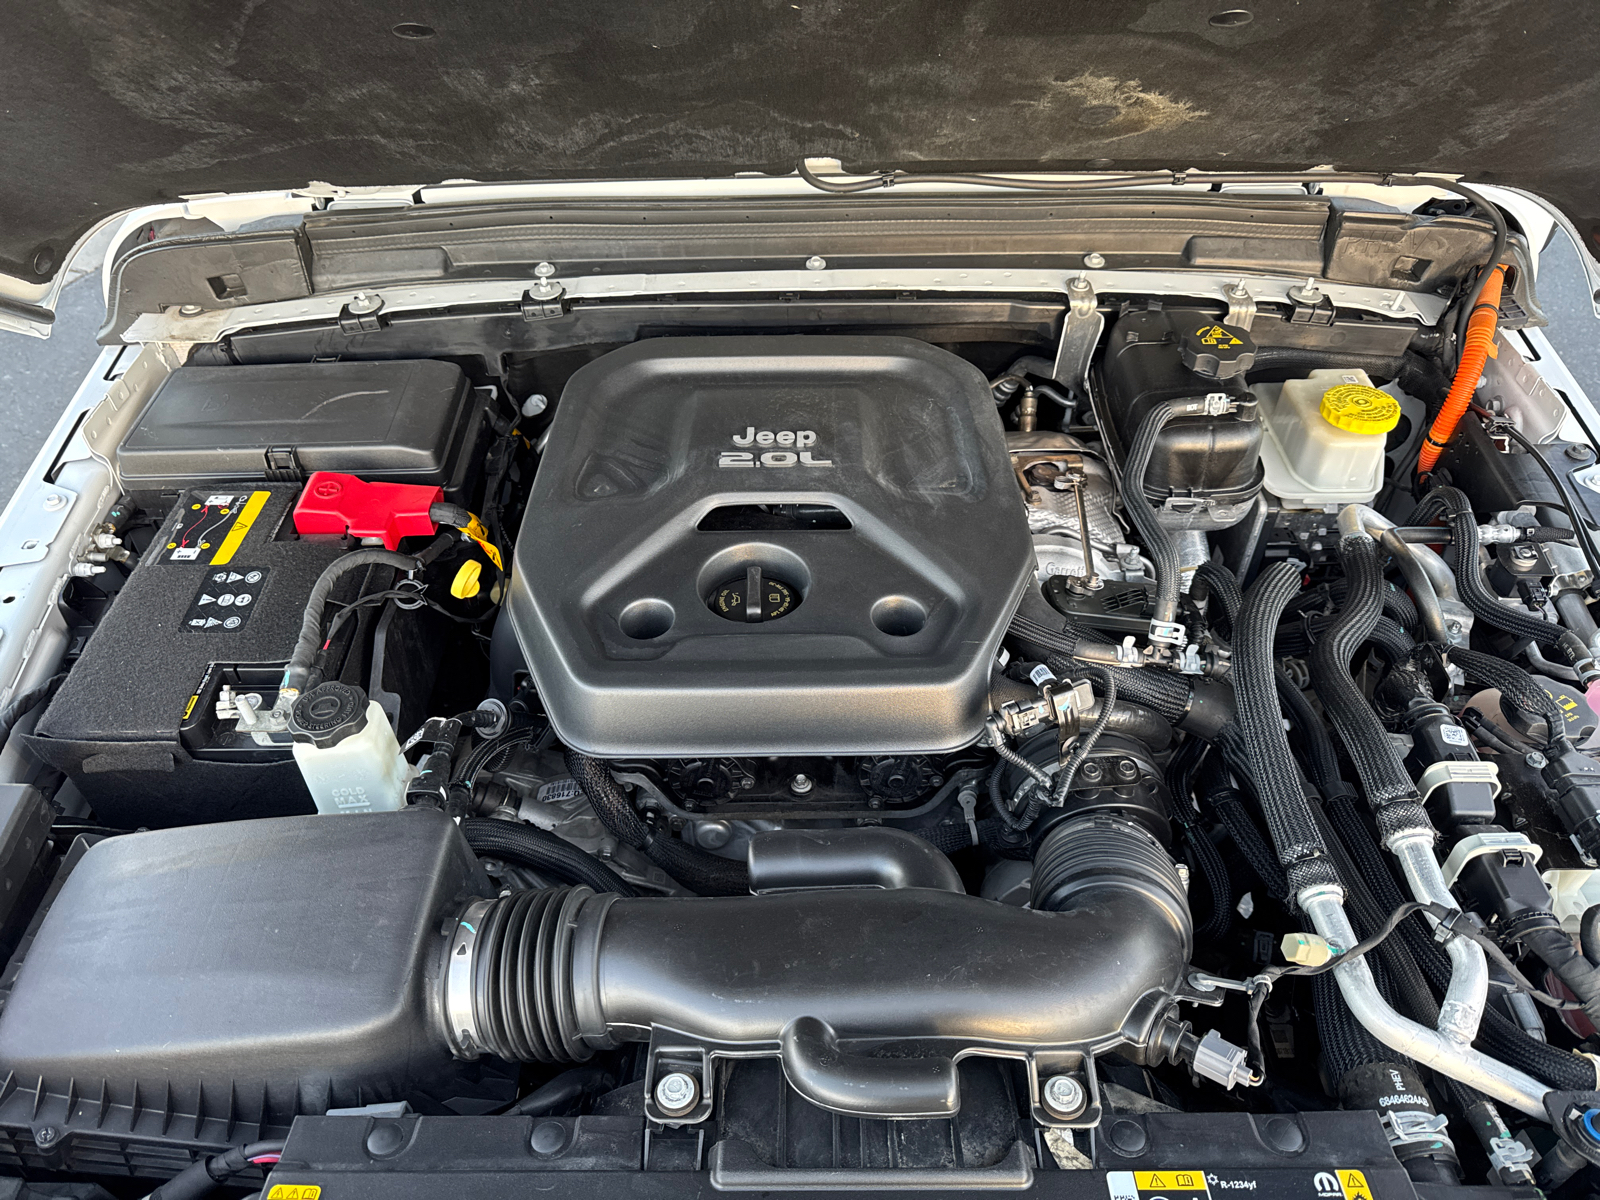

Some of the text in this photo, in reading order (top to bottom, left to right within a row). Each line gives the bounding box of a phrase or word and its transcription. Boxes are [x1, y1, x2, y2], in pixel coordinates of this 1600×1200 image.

[1342, 229, 1431, 254] PHEV
[733, 426, 817, 448] Jeep
[719, 451, 833, 468] 2.0L
[302, 685, 351, 702] USE APPROVED
[295, 709, 309, 728] POWER
[309, 717, 342, 730] STEERING
[332, 786, 365, 797] COLD
[334, 794, 369, 806] MAX
[1389, 1069, 1406, 1091] PHEV
[1220, 1180, 1257, 1191] R-1234yf
